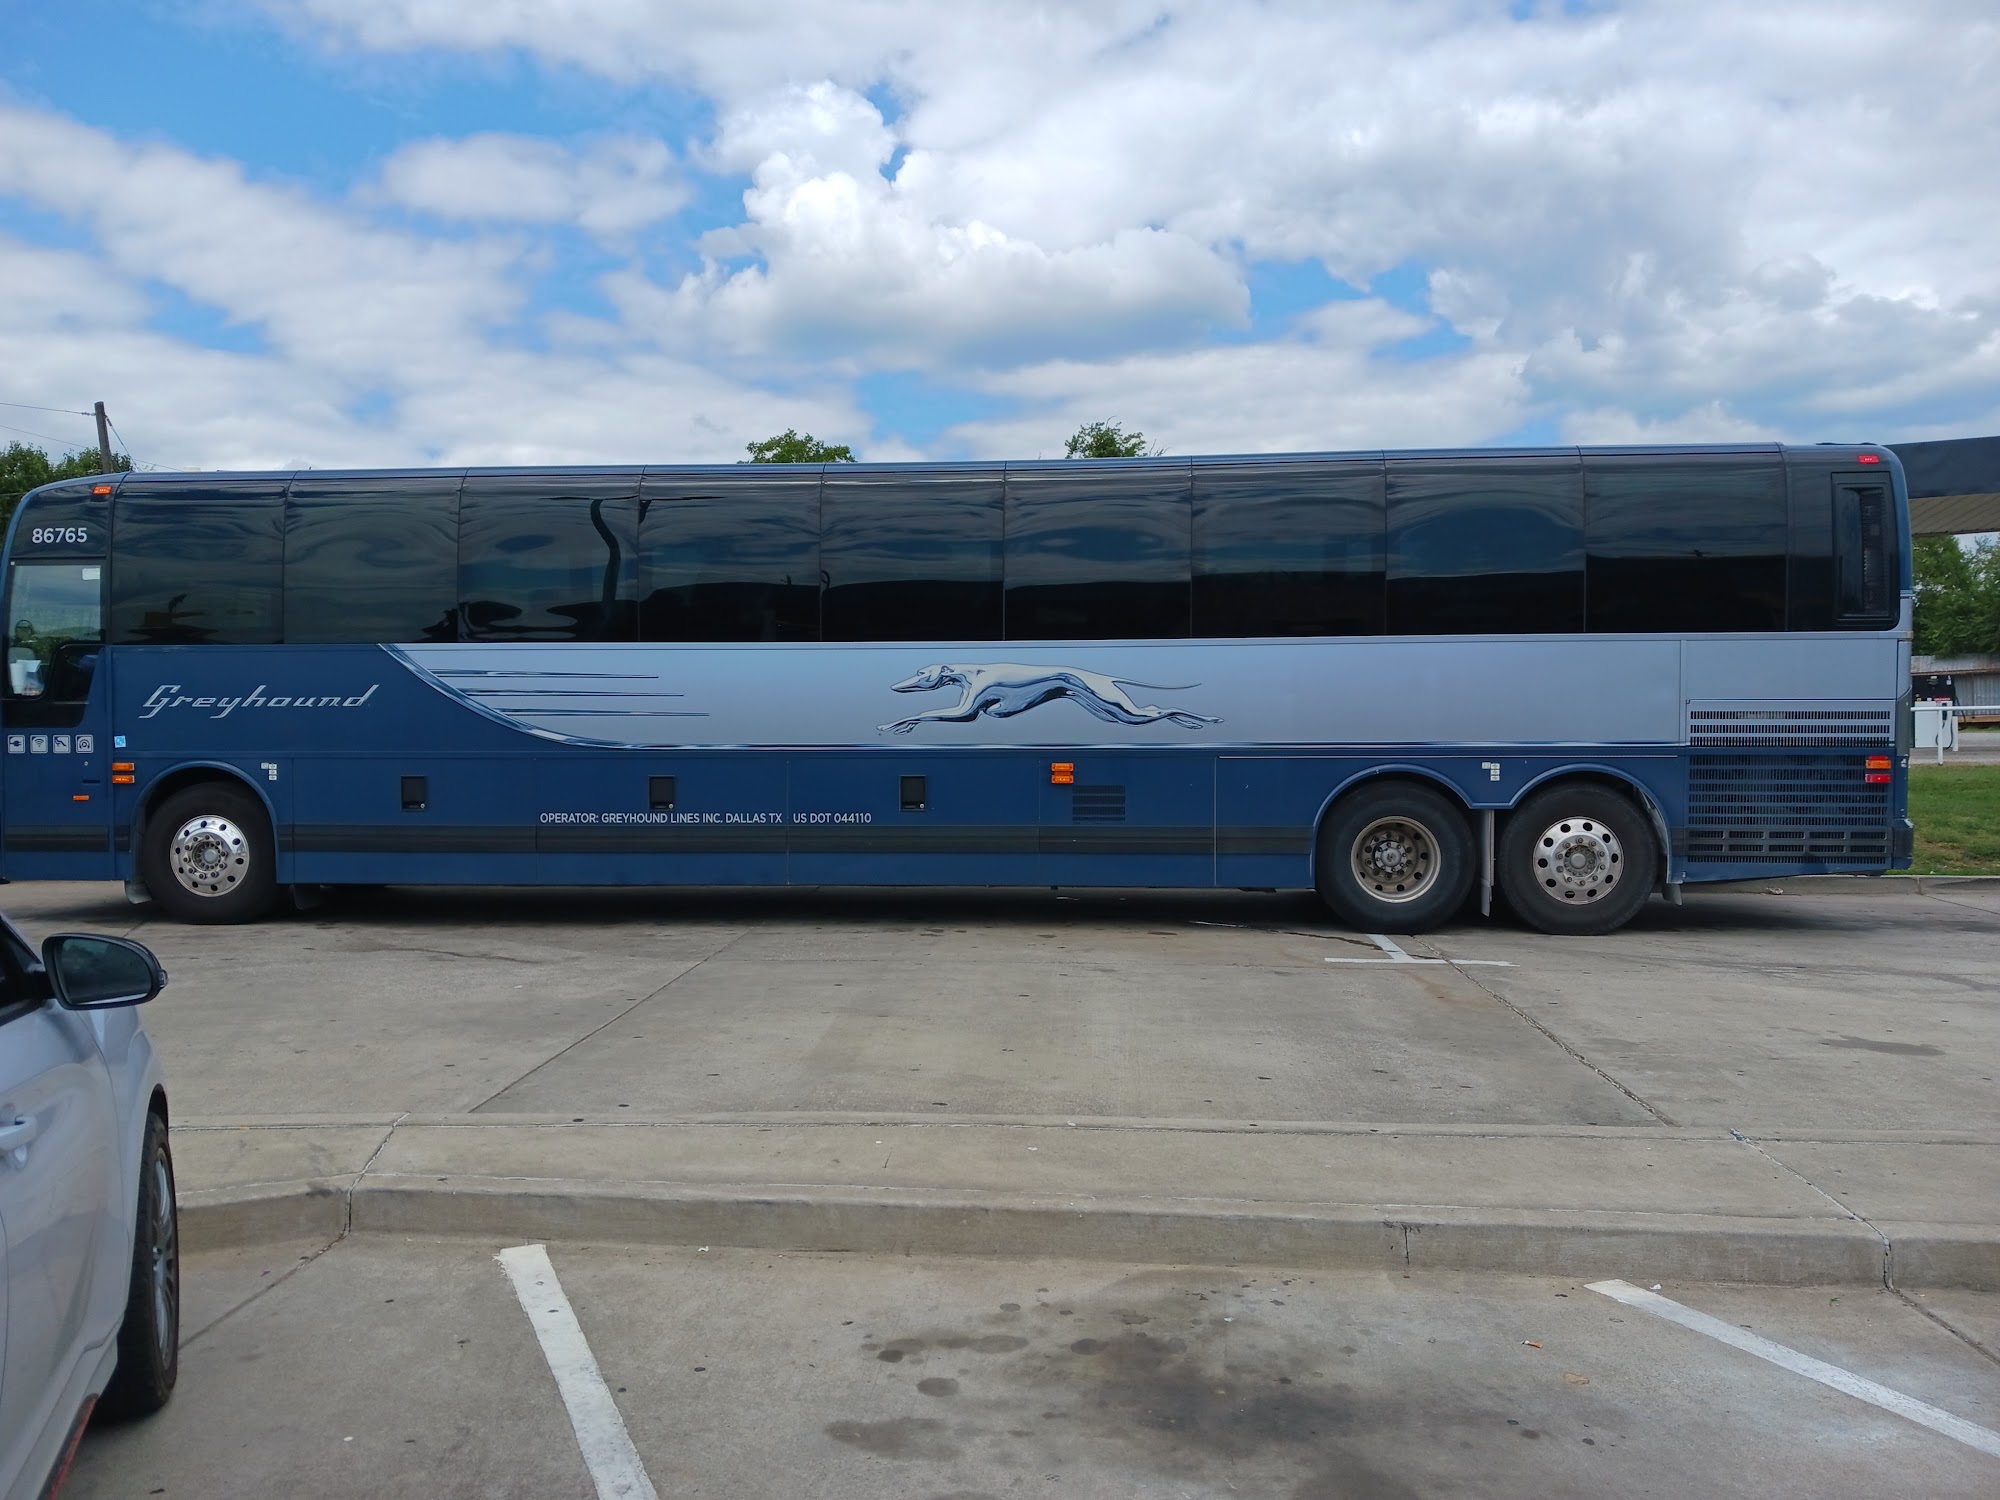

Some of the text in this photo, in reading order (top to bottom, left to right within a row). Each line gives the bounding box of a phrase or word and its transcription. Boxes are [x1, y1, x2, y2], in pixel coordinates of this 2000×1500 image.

[31, 527, 88, 544] 86765
[138, 684, 380, 719] Greyhound
[539, 812, 783, 824] OPERATOR: GREYHOUND LINES INC. DALLAS TX
[793, 812, 872, 824] US DOT 044110
